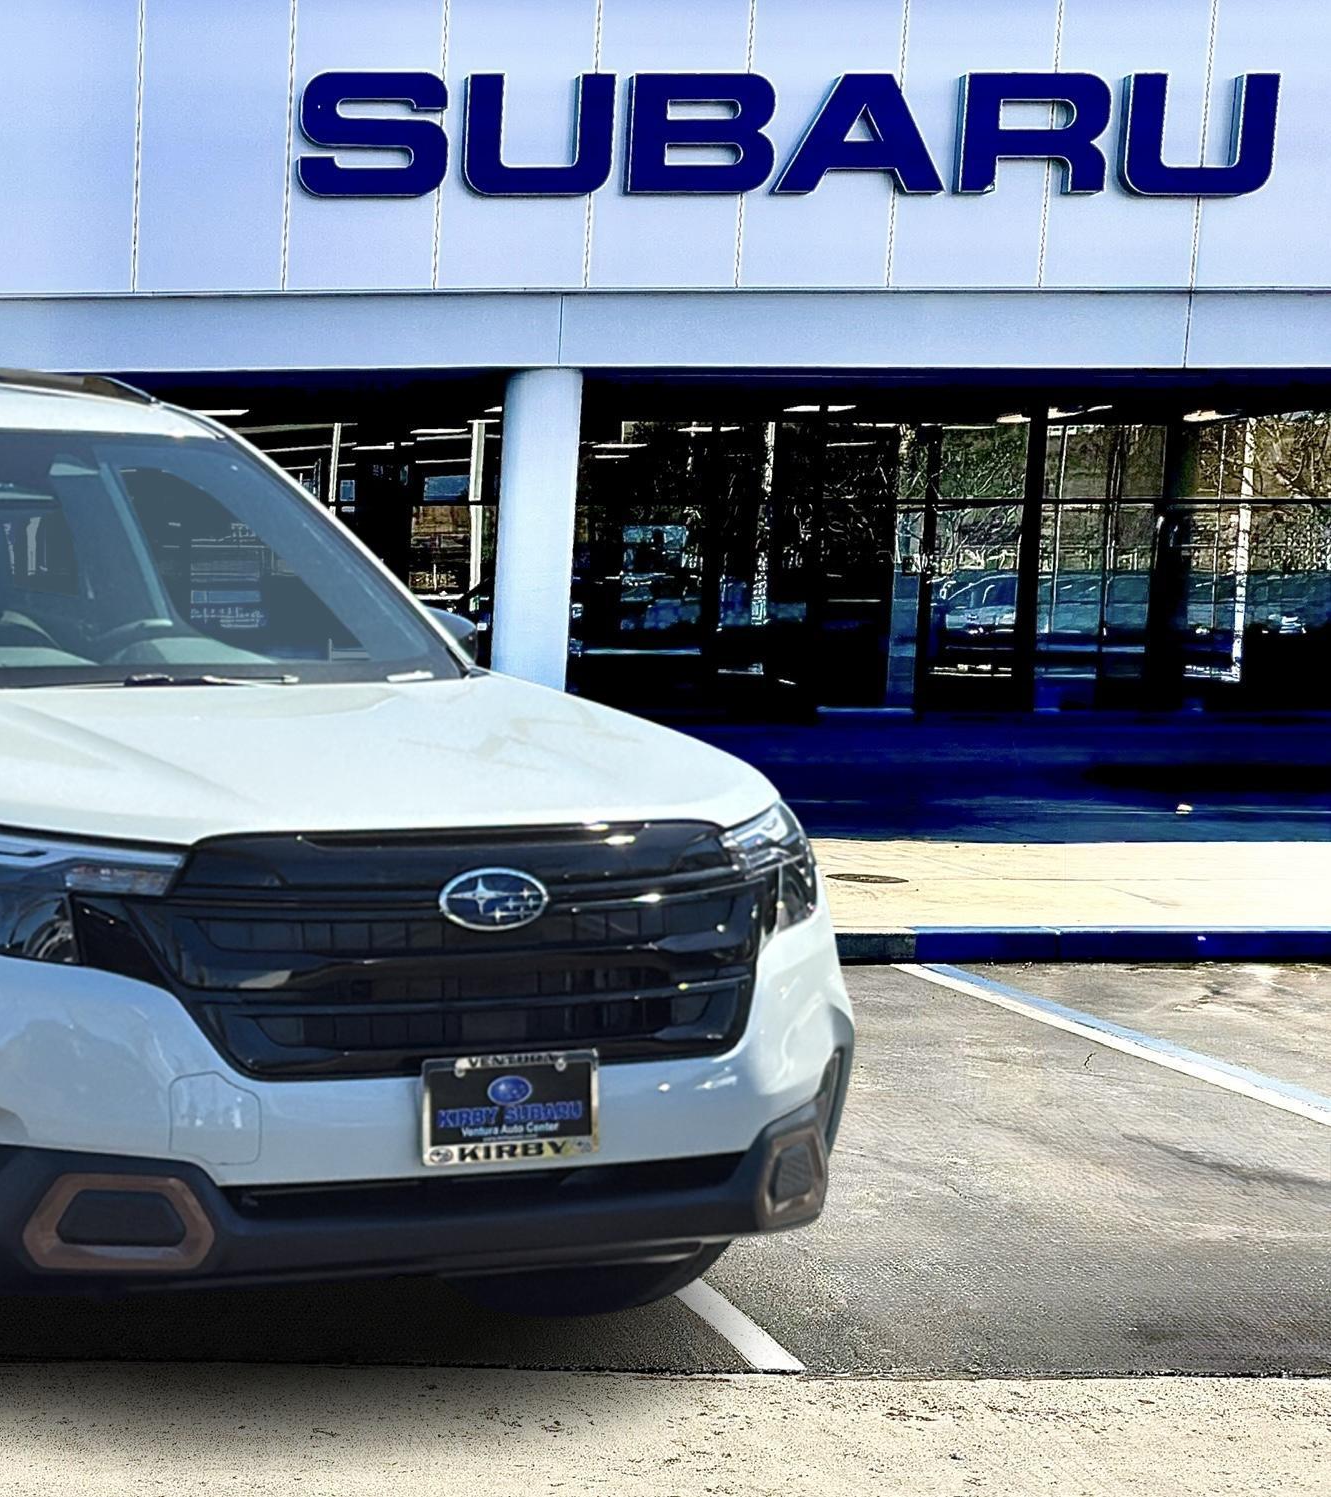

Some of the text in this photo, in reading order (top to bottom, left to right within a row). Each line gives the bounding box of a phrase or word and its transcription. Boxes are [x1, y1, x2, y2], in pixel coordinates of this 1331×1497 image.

[295, 69, 1282, 198] SUBARU
[468, 1053, 555, 1068] VENTURA
[438, 1102, 583, 1128] KIRBY SUBARU
[461, 1121, 560, 1138] Ventura Auto Center
[459, 1141, 567, 1161] KIRBY
